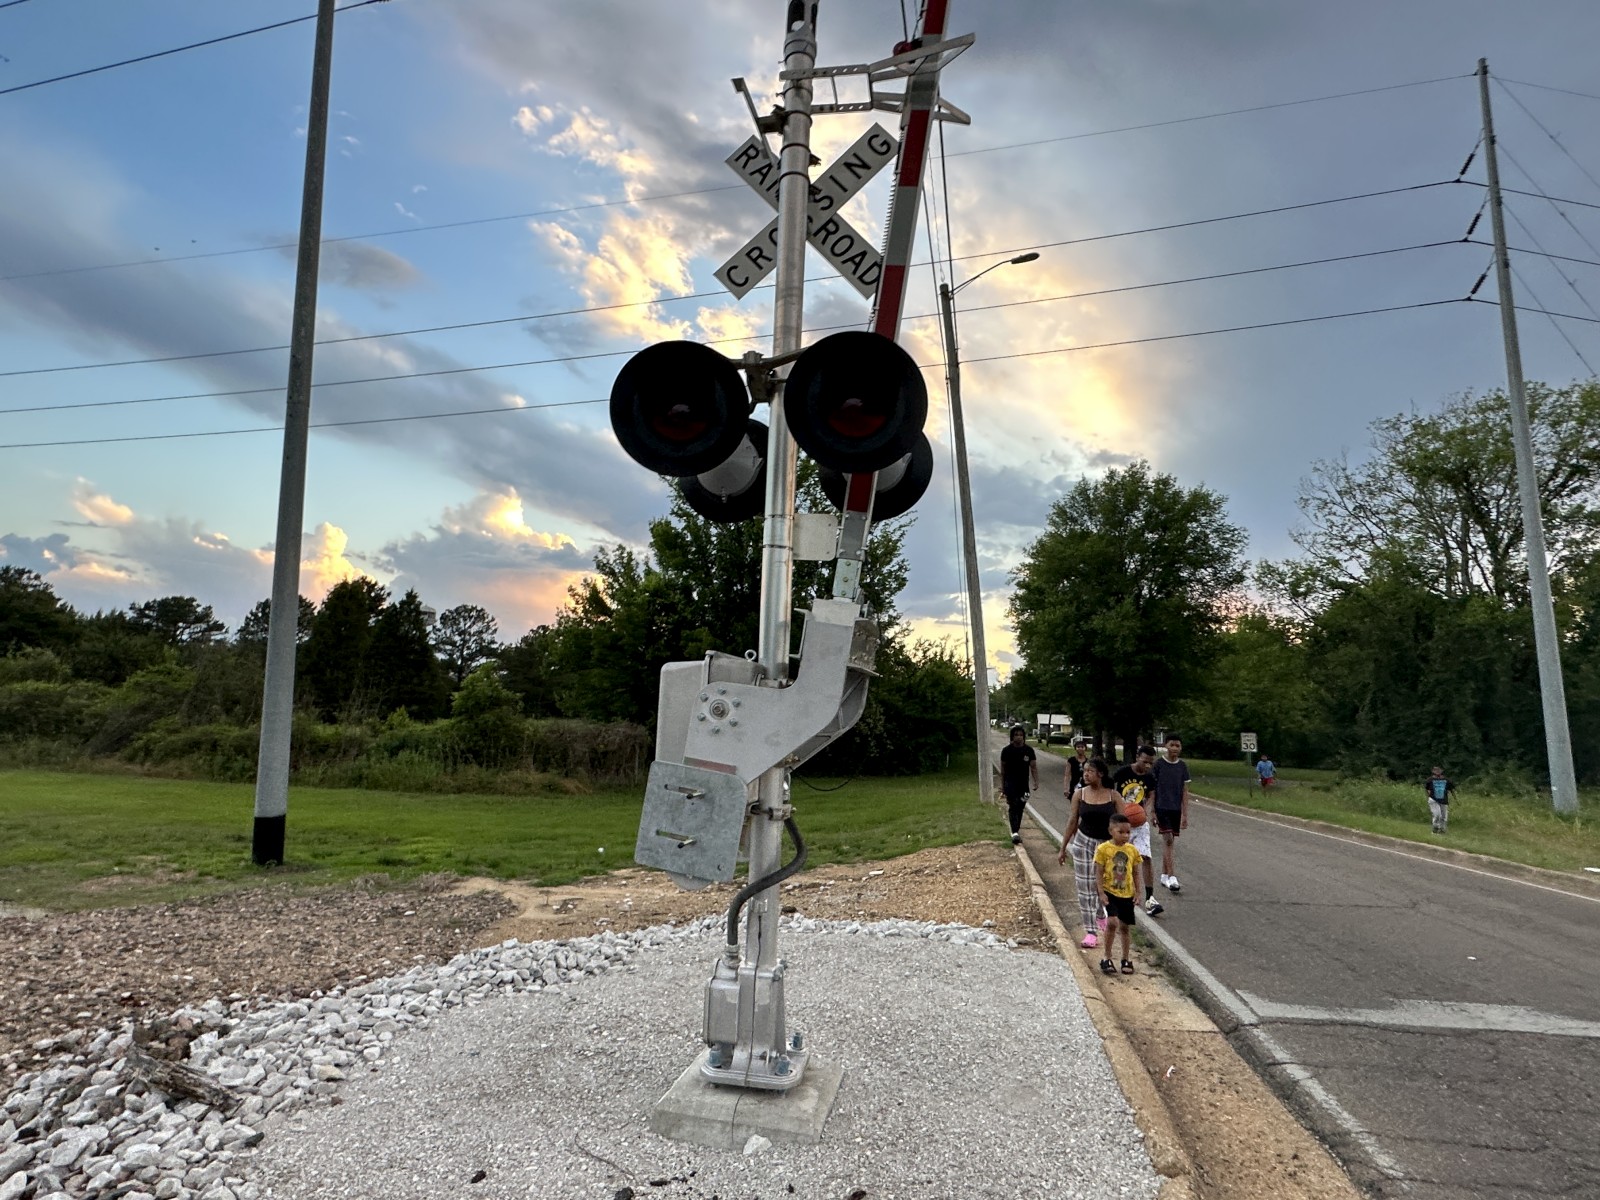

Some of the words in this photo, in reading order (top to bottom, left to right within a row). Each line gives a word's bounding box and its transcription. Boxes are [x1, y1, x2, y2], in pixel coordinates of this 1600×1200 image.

[726, 134, 892, 287] CRSING
[734, 143, 881, 286] RAIROAD
[1243, 742, 1256, 751] 30
